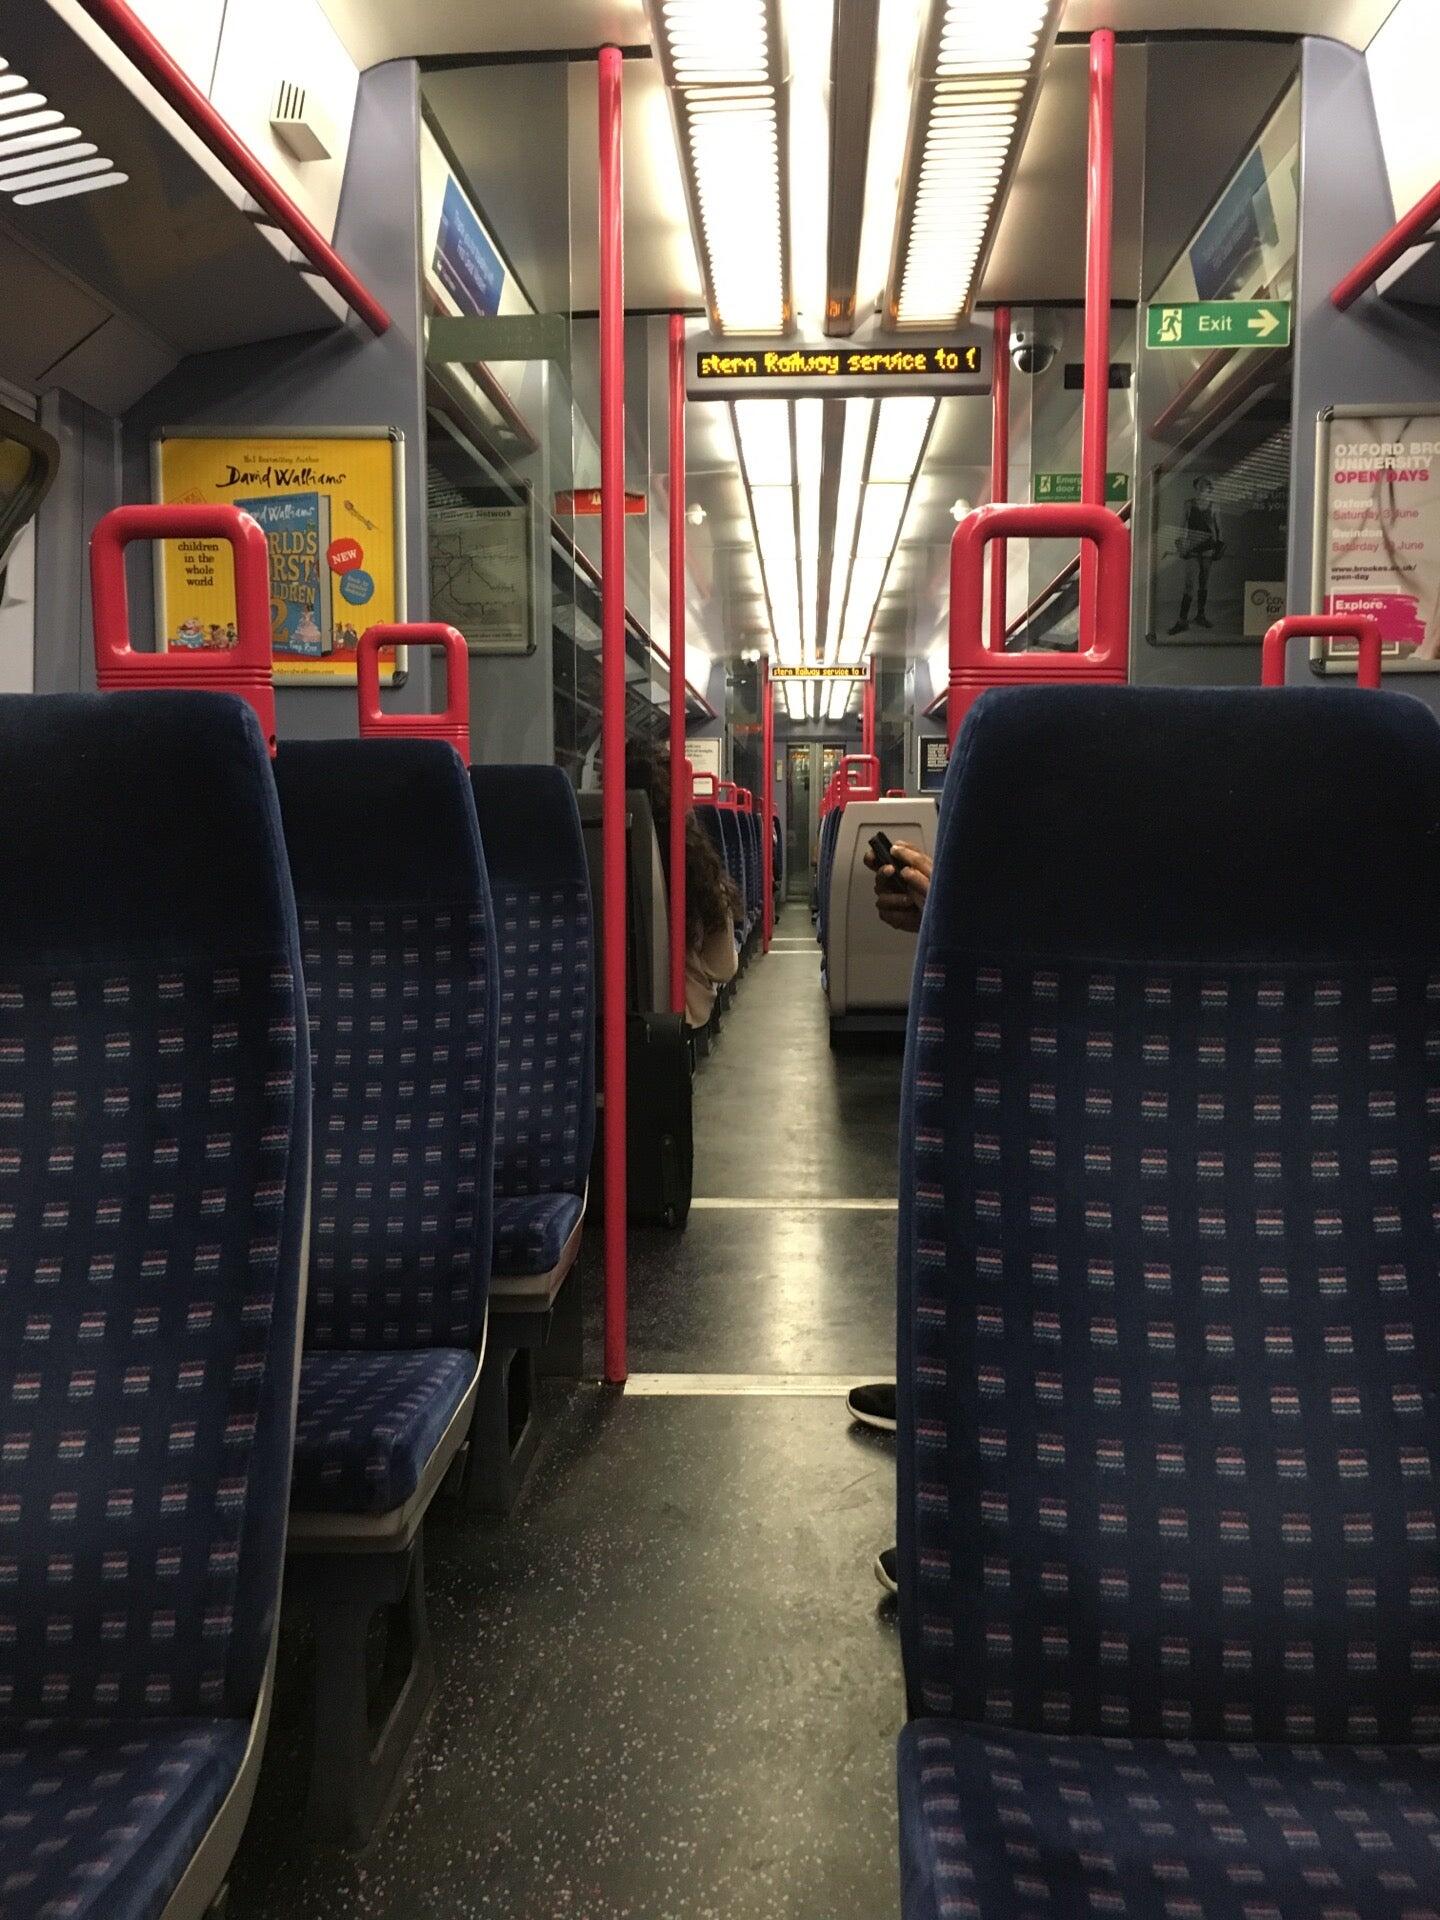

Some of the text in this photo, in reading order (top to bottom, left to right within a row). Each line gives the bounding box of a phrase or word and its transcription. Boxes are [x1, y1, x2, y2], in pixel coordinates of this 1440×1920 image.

[1198, 315, 1232, 331] Exit
[701, 354, 757, 374] stern
[764, 352, 839, 374] Railway
[848, 352, 927, 371] service
[934, 348, 958, 370] to
[1334, 442, 1405, 456] OXFORD
[1334, 456, 1433, 469] UNIVERSITY
[215, 465, 346, 488] David Walliams
[1334, 469, 1429, 483] OPEN DAYS
[1334, 498, 1373, 508] Oxford
[267, 504, 315, 521] Walliams
[476, 509, 511, 518] Network
[1333, 510, 1379, 521] Saturday
[178, 541, 219, 551] children
[268, 530, 317, 554] RLD'S
[1332, 541, 1379, 553] Saturday
[1400, 541, 1424, 551] June
[184, 553, 215, 563] in the
[332, 549, 357, 565] NEW
[185, 565, 214, 575] whole
[270, 554, 315, 582] RST
[186, 576, 213, 586] world
[1331, 572, 1369, 581] open-day
[1335, 599, 1387, 612] Explore.
[822, 667, 849, 676] service
